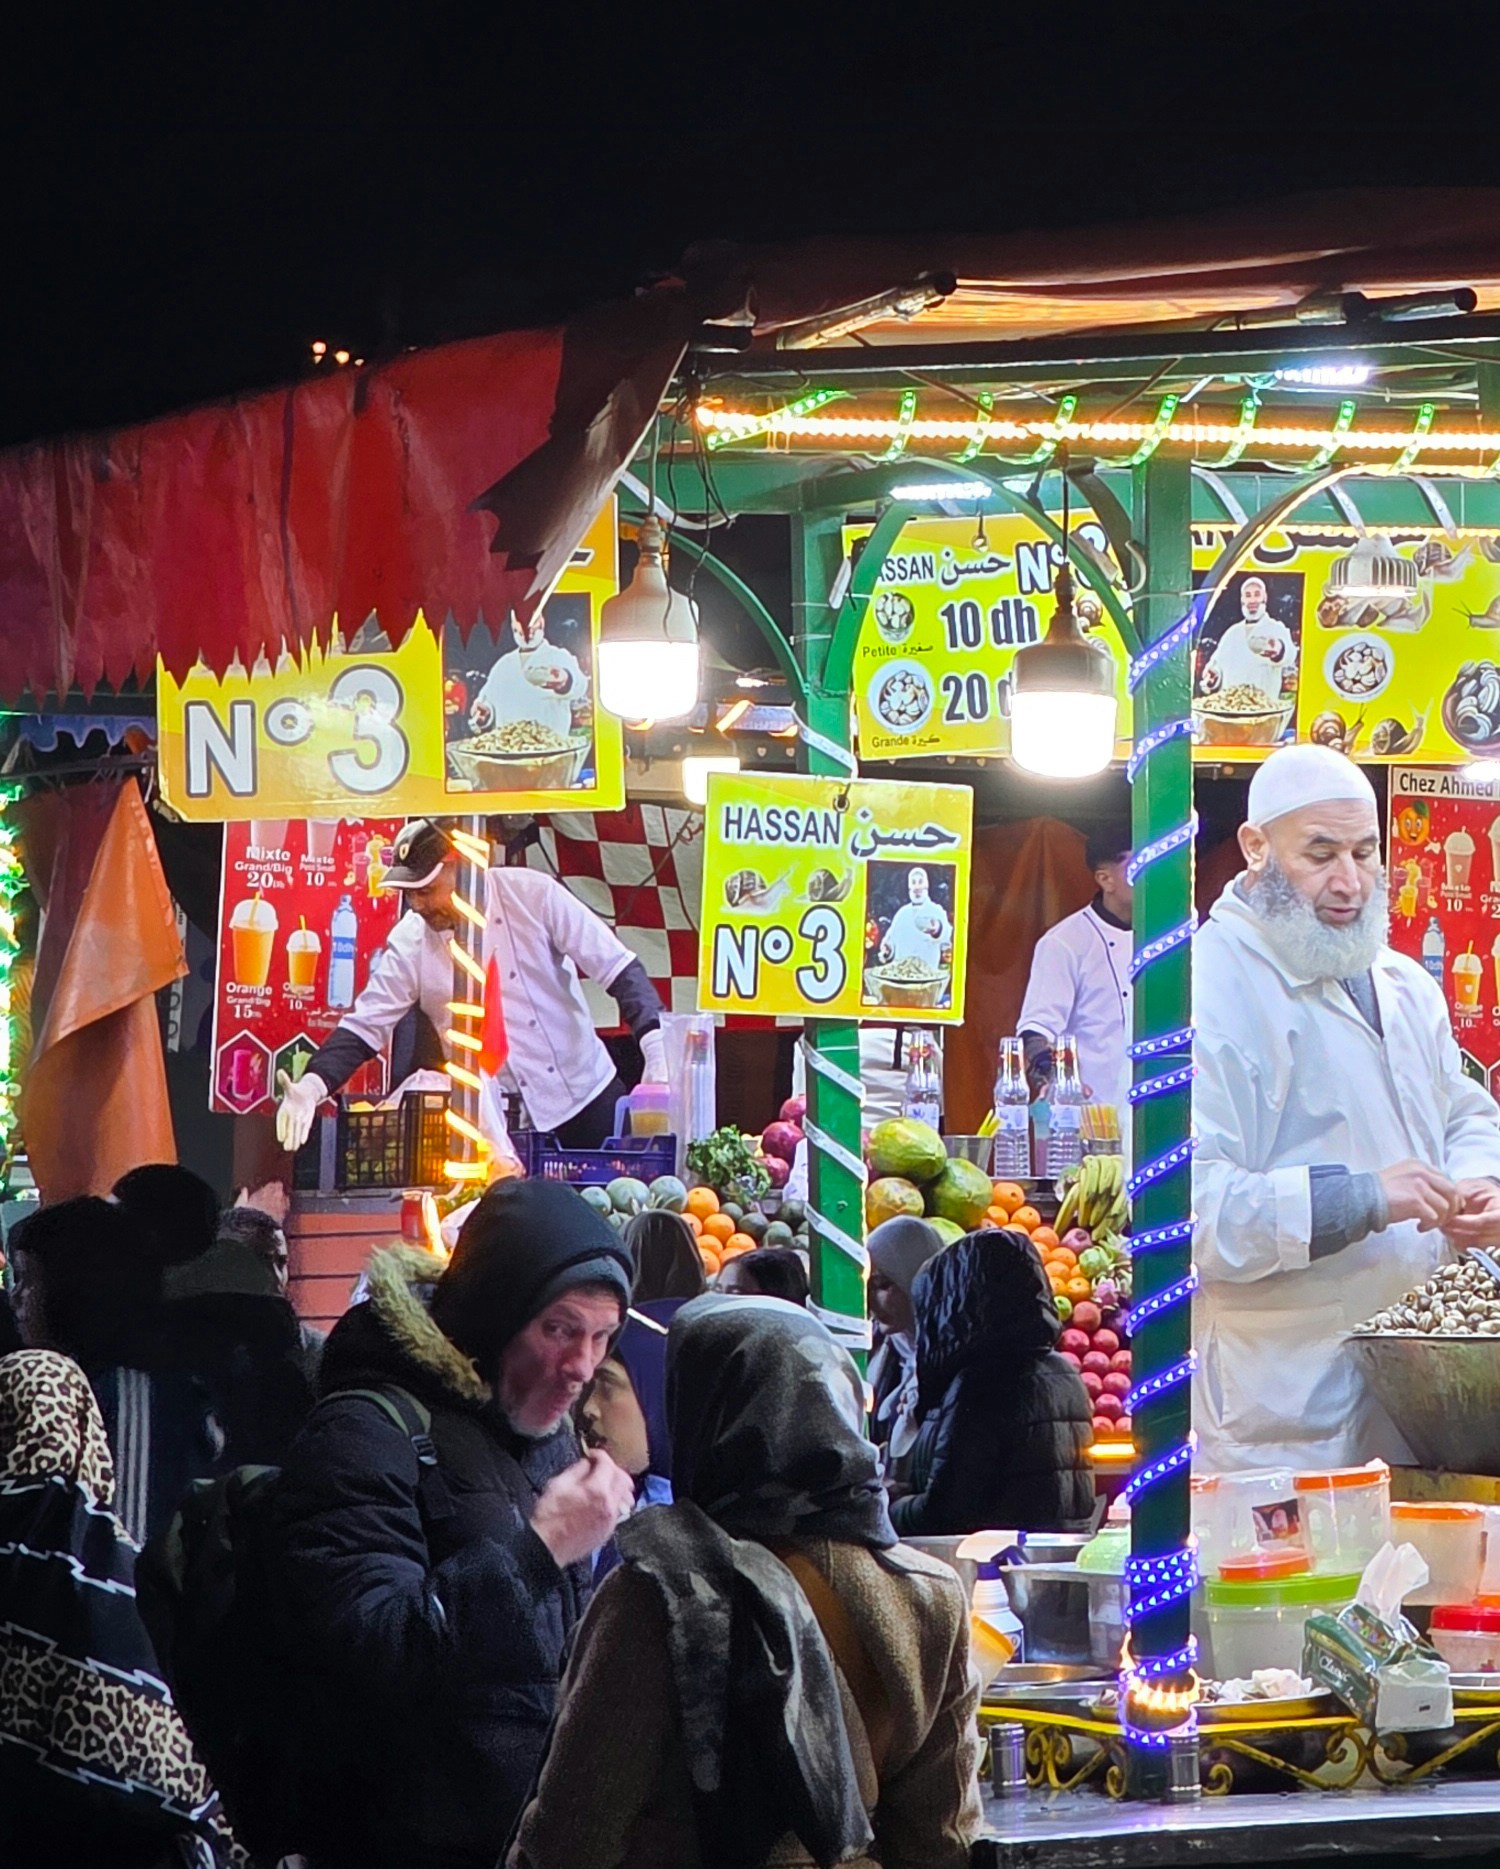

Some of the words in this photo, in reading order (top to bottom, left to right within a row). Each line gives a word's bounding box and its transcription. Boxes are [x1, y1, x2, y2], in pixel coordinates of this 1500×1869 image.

[880, 555, 934, 582] SSAN
[941, 550, 1011, 585] حسن
[941, 602, 982, 649] 10
[991, 598, 1037, 644] dh
[863, 646, 897, 658] Petite
[942, 673, 988, 721] 20
[185, 663, 410, 797] N°3
[872, 736, 909, 748] Grande
[1400, 773, 1435, 792] Chez
[1440, 776, 1493, 797] Ahmed
[724, 806, 840, 845] HASSAN
[851, 809, 957, 857] حسن
[235, 861, 293, 876] Grand/Big
[306, 872, 325, 886] 10
[712, 904, 847, 1003] N°3
[226, 982, 273, 997] Orange
